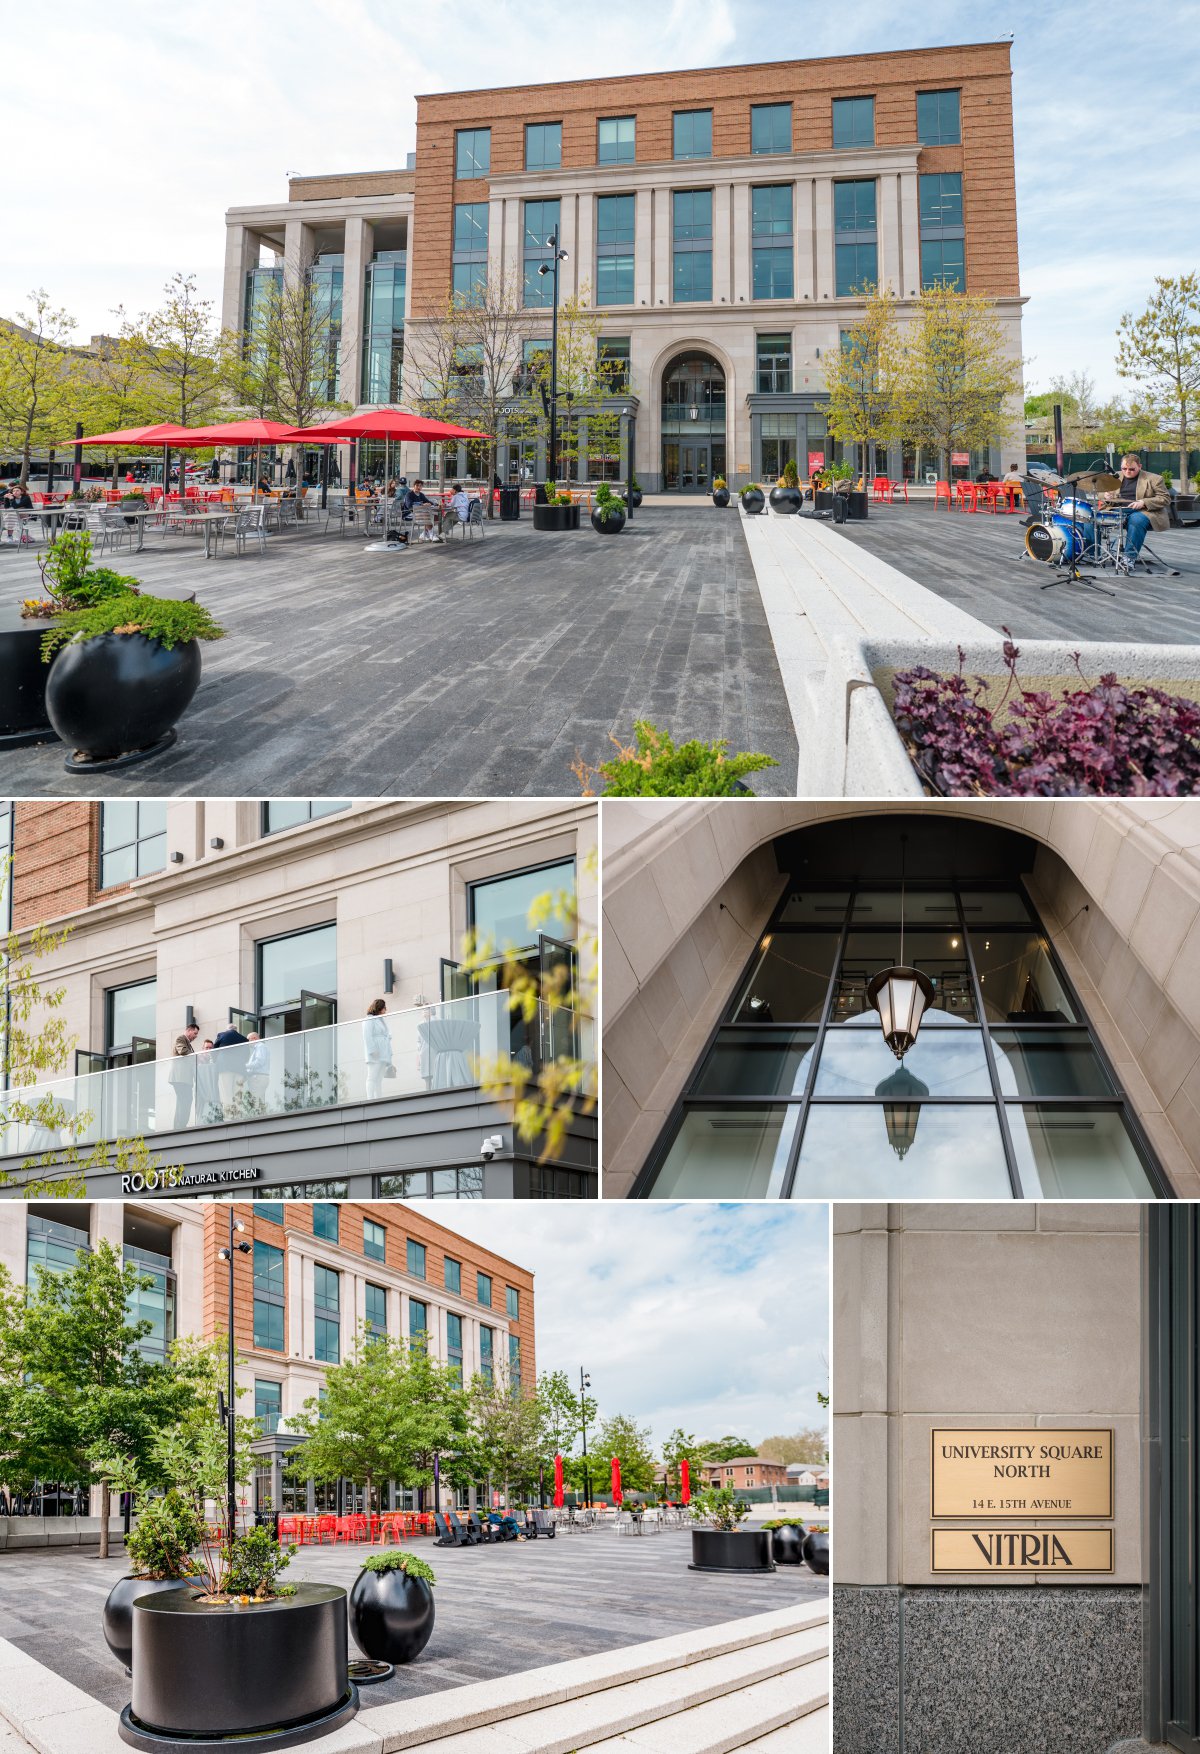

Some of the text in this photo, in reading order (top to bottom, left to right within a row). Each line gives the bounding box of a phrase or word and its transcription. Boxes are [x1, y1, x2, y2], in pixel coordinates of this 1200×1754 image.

[121, 1167, 257, 1193] ROOTS NATURAL KITCHEN
[942, 1445, 1103, 1460] UNIVERSITY SQUARE
[993, 1465, 1051, 1478] NORTH
[972, 1499, 1072, 1509] 14 E. 15TH AVENUE
[971, 1533, 1073, 1566] VITRIA
